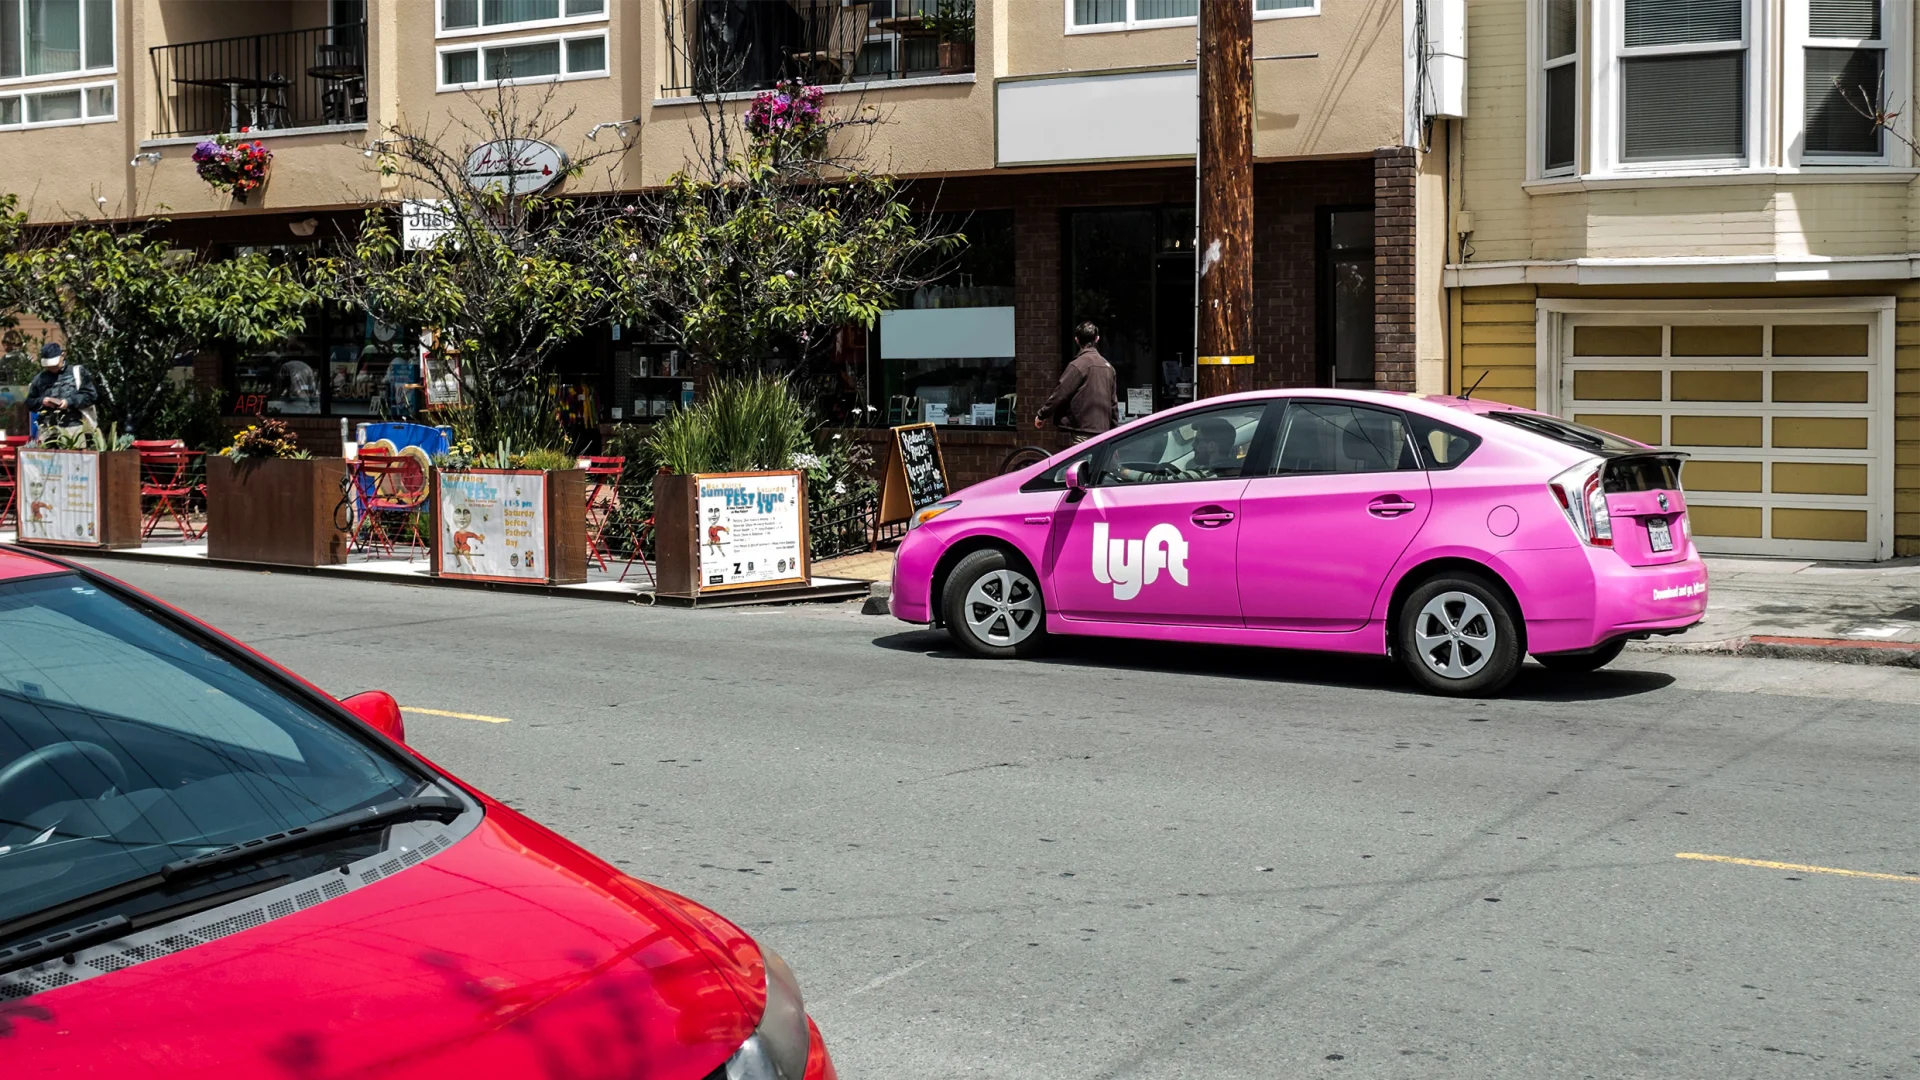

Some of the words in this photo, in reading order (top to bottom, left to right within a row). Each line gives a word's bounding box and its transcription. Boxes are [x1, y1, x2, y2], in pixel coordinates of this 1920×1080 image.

[410, 207, 451, 227] Just
[234, 395, 267, 414] ART
[906, 454, 934, 482] Recycle!
[467, 487, 497, 500] FEST
[701, 487, 746, 498] Summer
[757, 492, 785, 503] June
[521, 500, 533, 508] pm
[726, 493, 755, 506] FEST
[504, 509, 535, 518] Saturday
[504, 519, 528, 527] before
[505, 529, 532, 537] Father's
[505, 539, 519, 547] Day
[1092, 522, 1188, 600] lyft
[1653, 586, 1679, 600] Download
[1678, 584, 1687, 597] and
